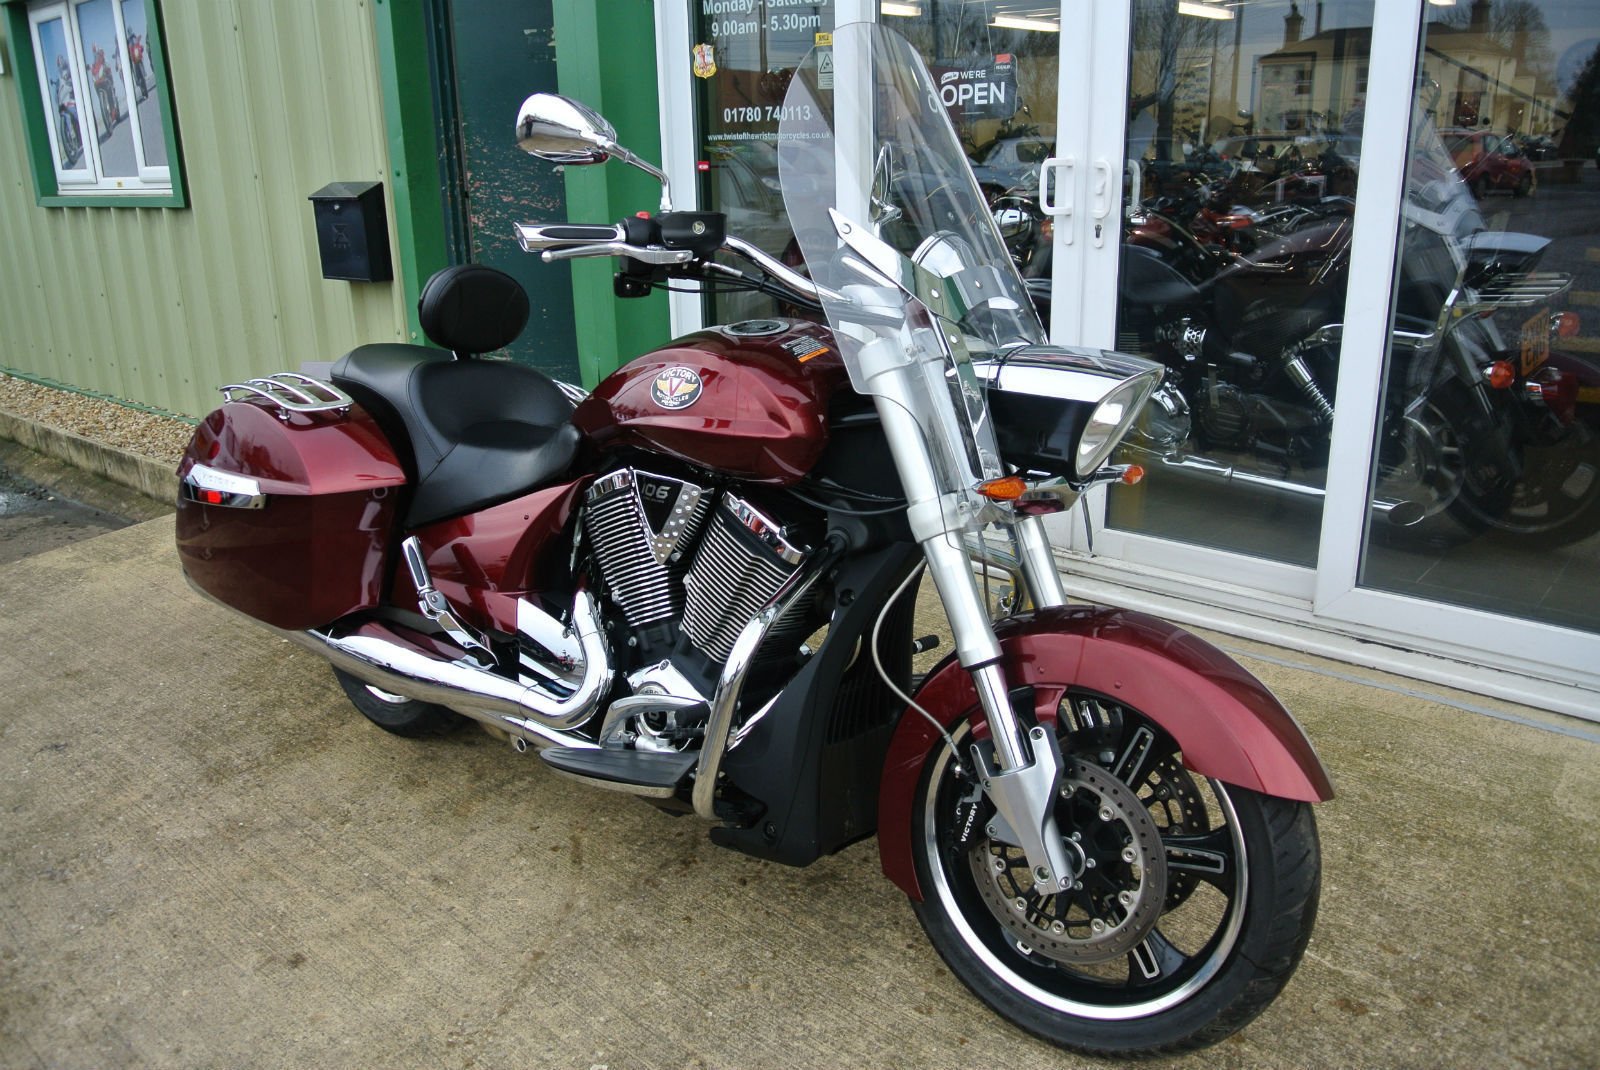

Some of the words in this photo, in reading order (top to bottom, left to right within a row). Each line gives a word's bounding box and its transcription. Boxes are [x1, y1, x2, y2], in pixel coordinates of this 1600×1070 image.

[703, 0, 753, 15] Monday
[711, 20, 758, 37] 9.00am
[770, 14, 821, 32] 5.30pm
[960, 70, 987, 79] WE'RE
[941, 82, 1005, 107] OPEN
[724, 106, 761, 123] 01780
[765, 105, 811, 122] 740113
[662, 369, 697, 383] VICTORY
[642, 482, 671, 499] 106
[961, 803, 977, 841] VICTORY
